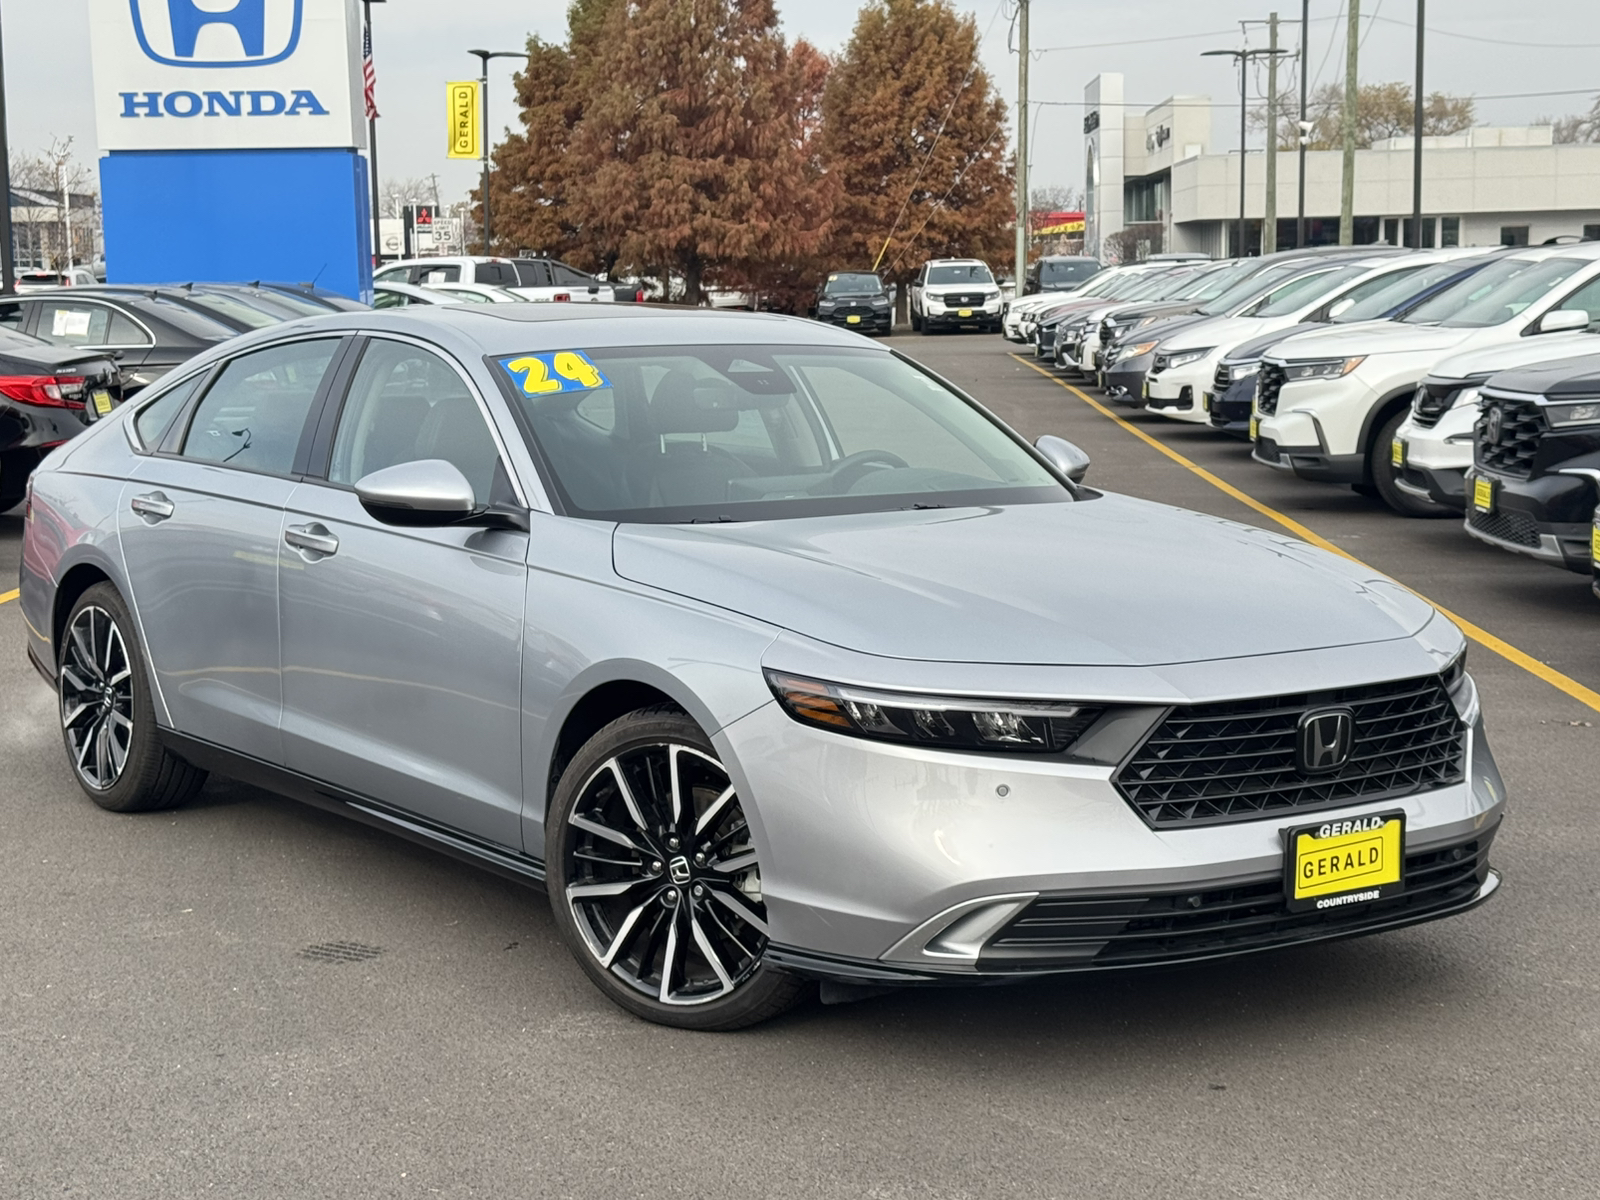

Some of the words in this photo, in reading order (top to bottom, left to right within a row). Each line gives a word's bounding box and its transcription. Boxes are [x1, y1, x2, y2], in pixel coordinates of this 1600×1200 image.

[118, 90, 330, 118] HONDA
[459, 91, 469, 149] GERALD
[435, 231, 451, 241] 35
[507, 352, 604, 395] 24
[1319, 816, 1381, 839] GERALD
[1303, 846, 1379, 879] GERALD
[1316, 890, 1380, 909] COUNTRYSIDE
